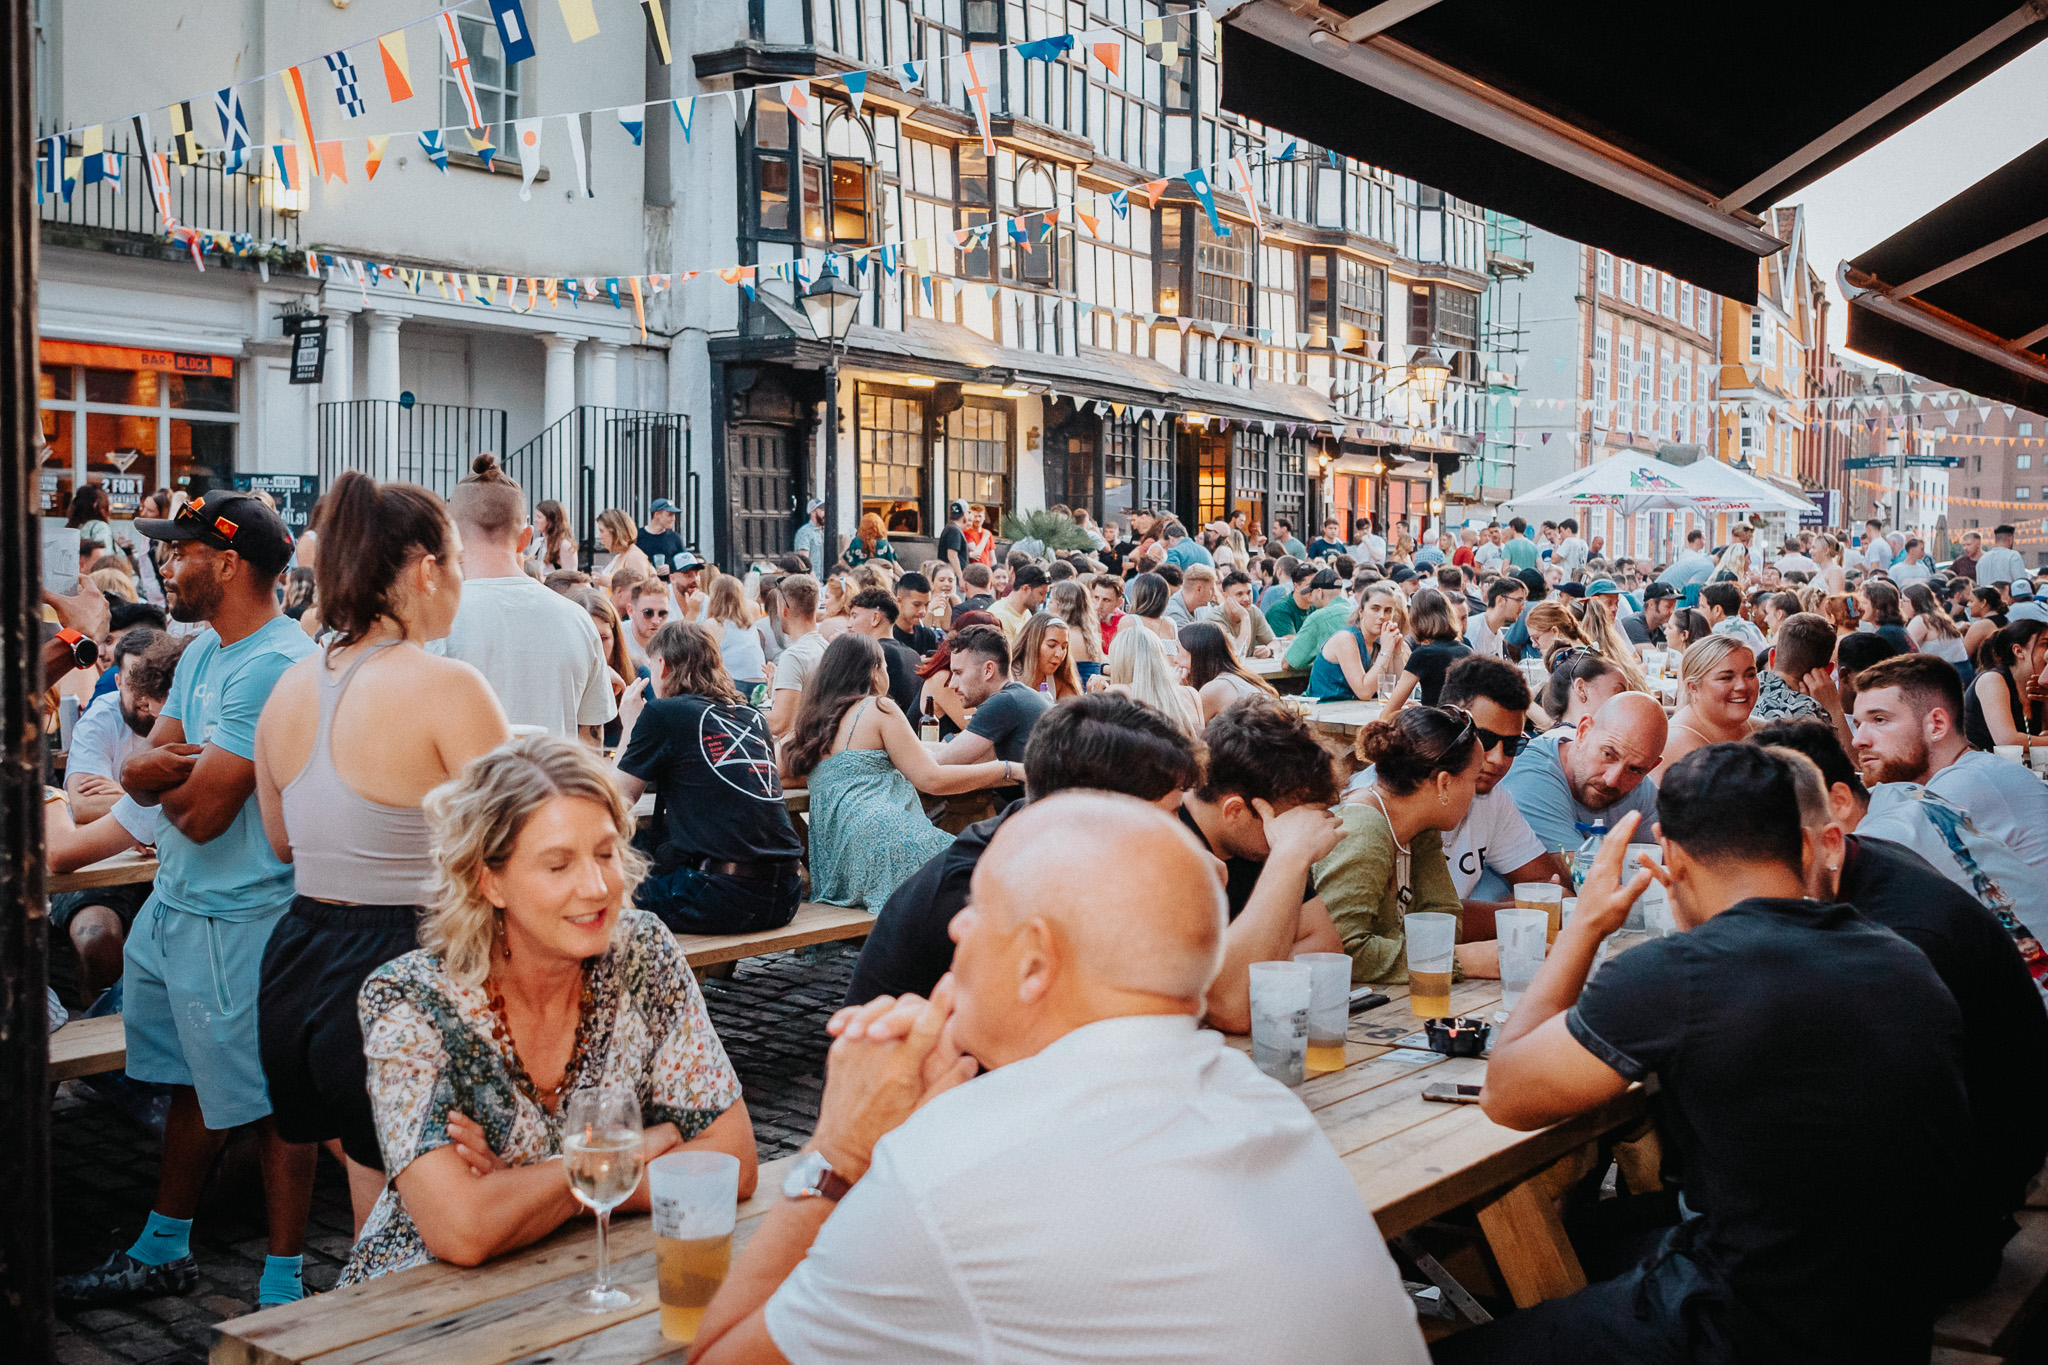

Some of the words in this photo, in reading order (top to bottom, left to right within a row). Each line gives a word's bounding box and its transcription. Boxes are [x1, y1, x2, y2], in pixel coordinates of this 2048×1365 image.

[176, 356, 209, 370] BLOCK
[101, 479, 111, 493] 2
[112, 479, 135, 494] FOR
[136, 479, 143, 493] 1
